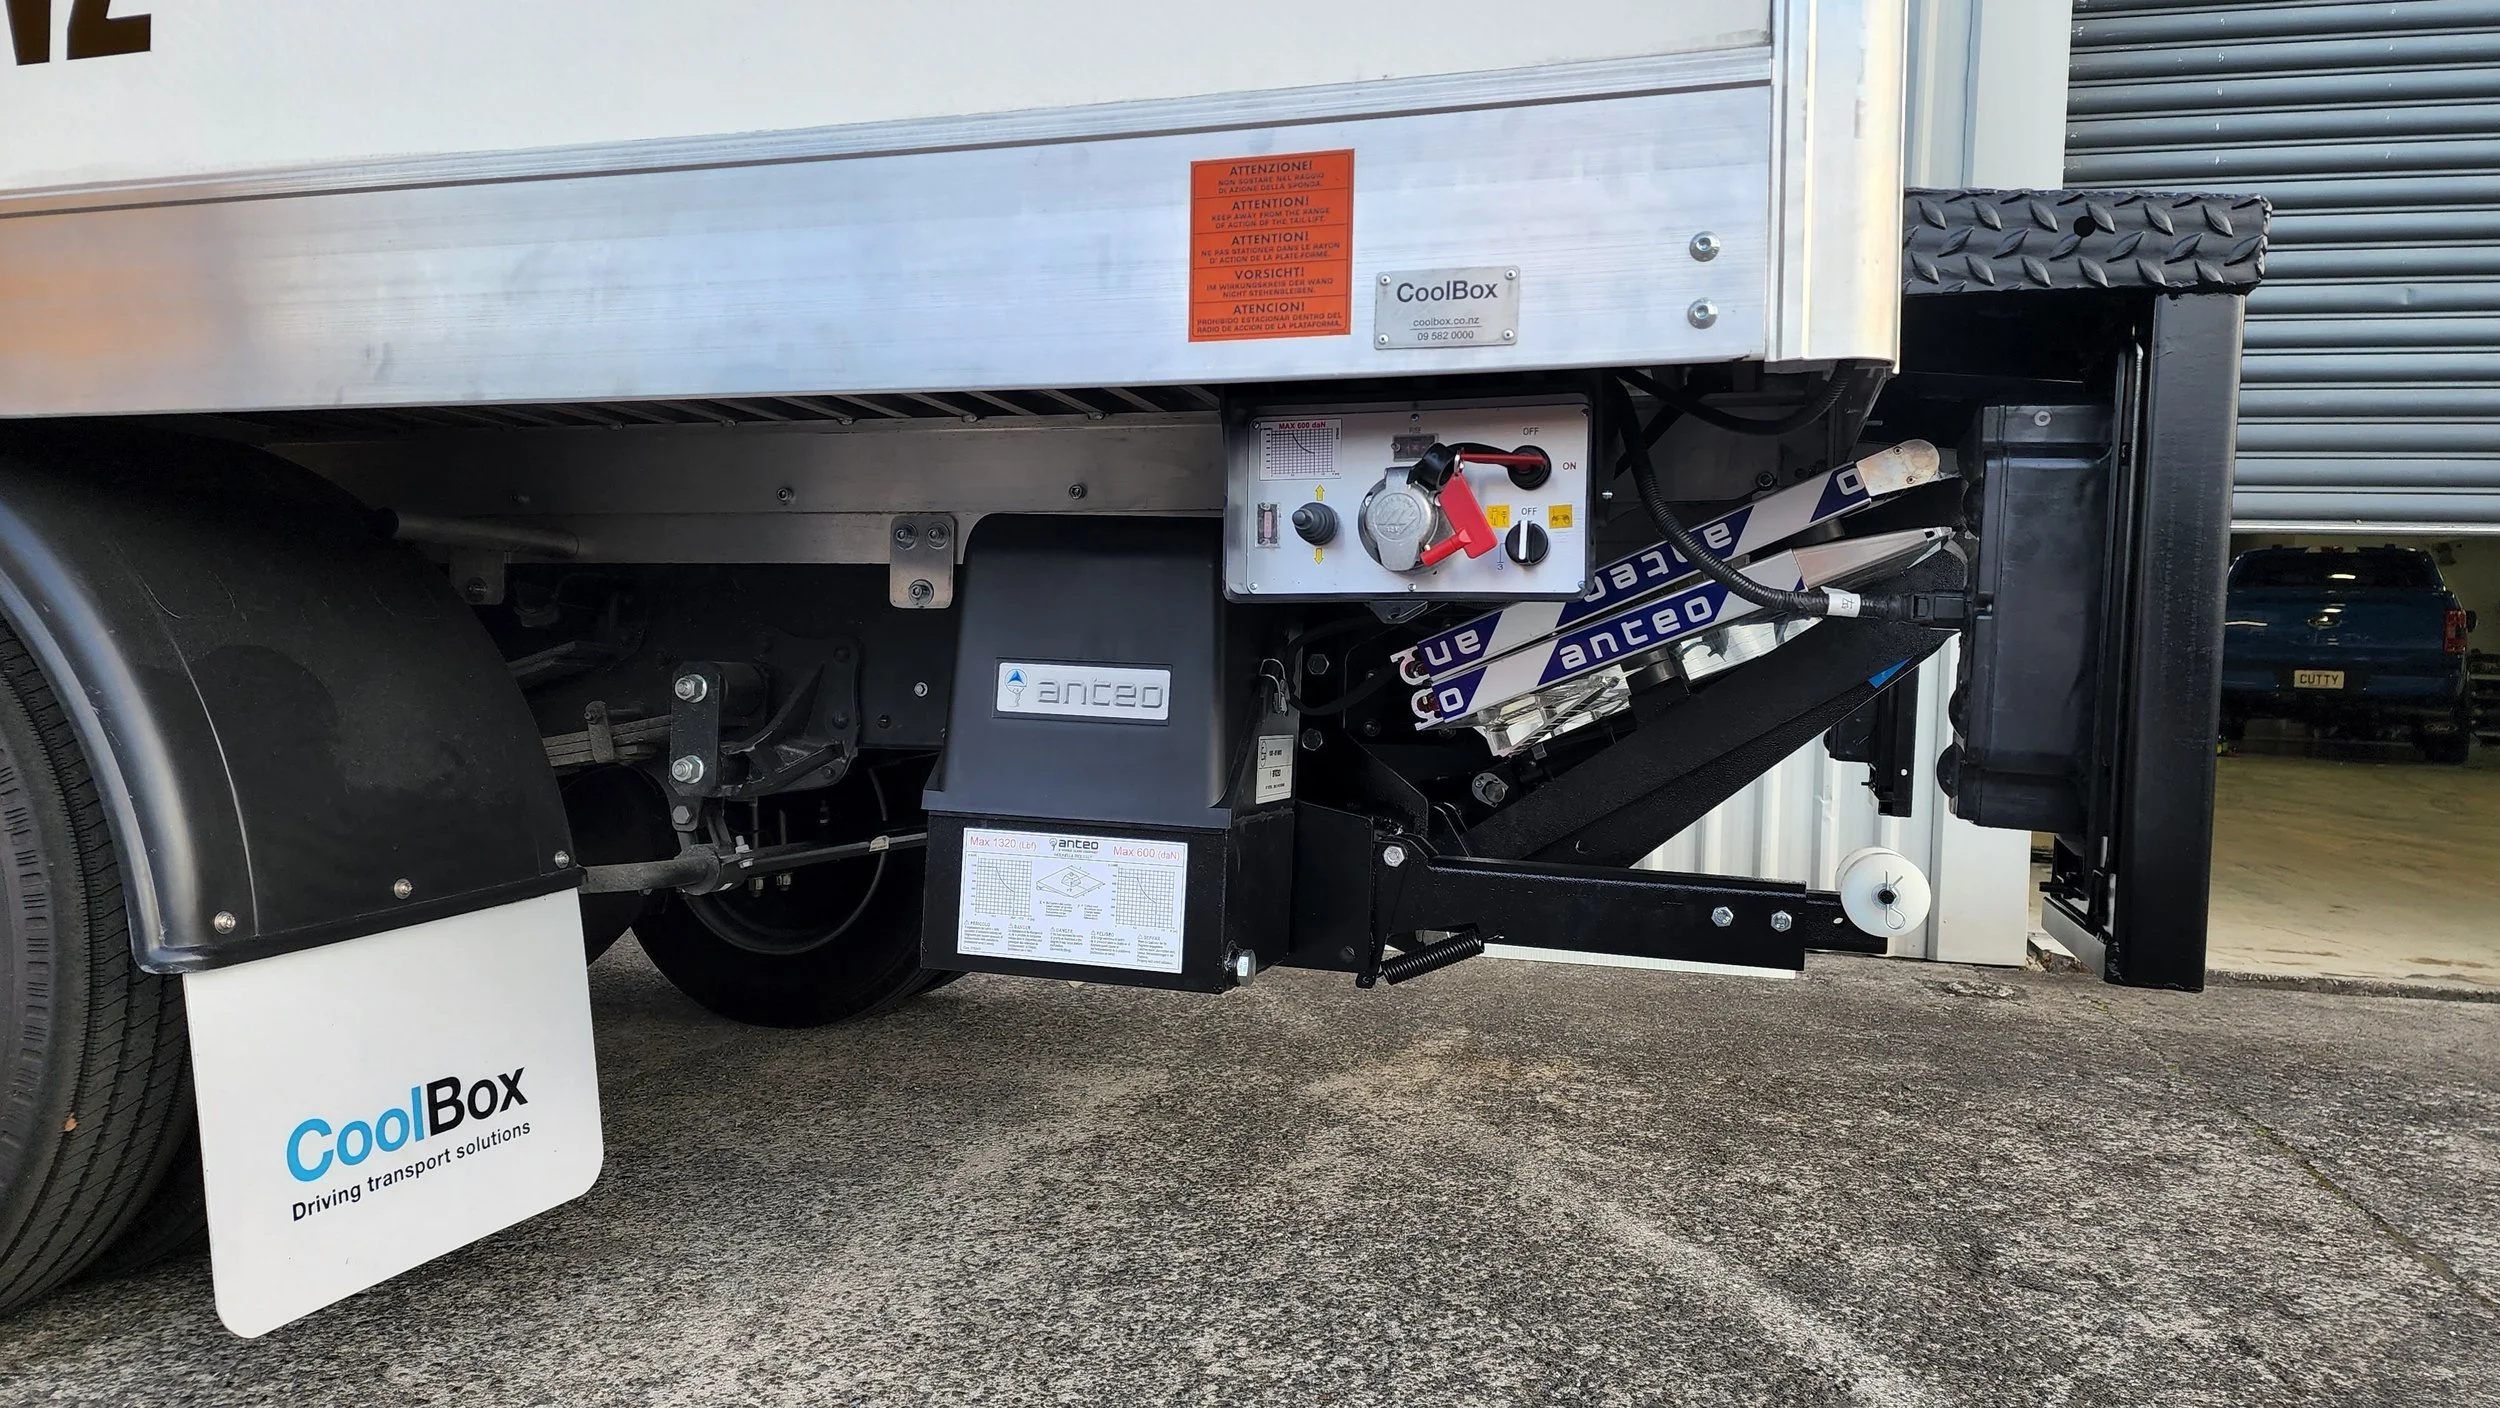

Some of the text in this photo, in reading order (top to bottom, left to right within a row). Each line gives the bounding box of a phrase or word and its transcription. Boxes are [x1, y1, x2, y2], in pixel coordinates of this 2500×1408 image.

[1229, 161, 1312, 177] ATTENZIONE!
[1217, 179, 1236, 187] NON
[1237, 176, 1273, 185] SOSTARE
[1293, 173, 1324, 181] RAGGIO
[1228, 185, 1258, 194] AZIONE
[1259, 183, 1285, 192] DELLA
[1231, 196, 1309, 211] ATTENTION!
[1210, 214, 1232, 222] KEEP
[1233, 213, 1256, 221] AWAY
[1258, 211, 1283, 219] FROM
[1301, 208, 1329, 216] RANGE
[1214, 222, 1226, 230] OF
[1227, 220, 1257, 229] ACTION
[1258, 219, 1269, 227] OF
[1271, 218, 1287, 226] THE
[1289, 217, 1305, 225] TAIL
[1231, 231, 1309, 246] ATTENTION!
[1275, 245, 1299, 253] DANS
[1311, 243, 1340, 251] RAYON
[1218, 256, 1248, 264] ACTION
[1234, 267, 1304, 280] VORSICHT!
[1218, 281, 1287, 291] WIRKUNGSKREIS
[1306, 278, 1333, 286] WAND
[1396, 280, 1498, 302] CoolBox
[1232, 302, 1305, 316] ATENCION!
[1196, 317, 1239, 326] PROHIBIDO
[1240, 315, 1290, 324] ESTACIONAR
[1291, 313, 1325, 321] DENTRO
[1413, 316, 1480, 327] coolbox.co.nz
[1196, 326, 1220, 334] RADIO
[1417, 330, 1475, 341] 09 582 0000
[1278, 421, 1327, 430] MAX 600 daN
[1522, 427, 1540, 436] OFF
[1562, 461, 1577, 470] ON
[1521, 507, 1537, 516] OFF
[1497, 563, 1504, 571] 3
[1559, 596, 1713, 670] anteo
[2300, 673, 2339, 685] CUTTY
[1037, 676, 1164, 710] anteo
[969, 835, 990, 847] Max
[993, 836, 1017, 849] 1320
[1059, 839, 1099, 850] anteo
[1113, 845, 1180, 861] Max 600 (daN)
[286, 1067, 529, 1182] CoolBox
[292, 1121, 531, 1221] Driving transport solutions
